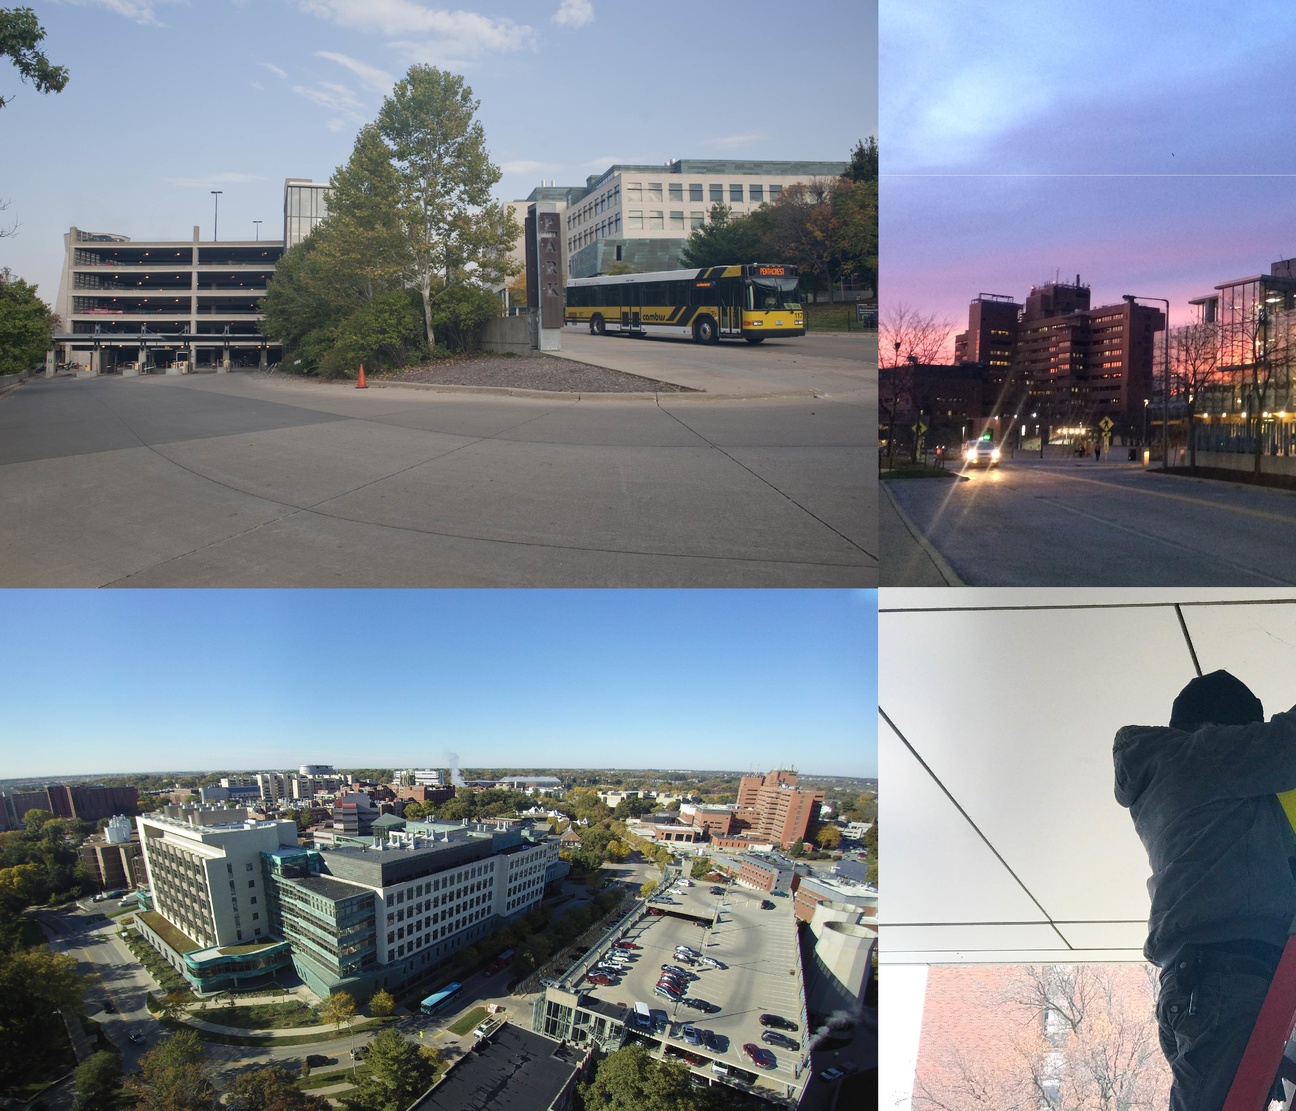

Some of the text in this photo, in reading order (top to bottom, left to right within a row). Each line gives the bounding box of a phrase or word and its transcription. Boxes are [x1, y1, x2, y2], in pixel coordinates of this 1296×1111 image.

[544, 216, 560, 297] PARK
[760, 267, 785, 276] PENTACREST
[642, 312, 666, 321] cambus
